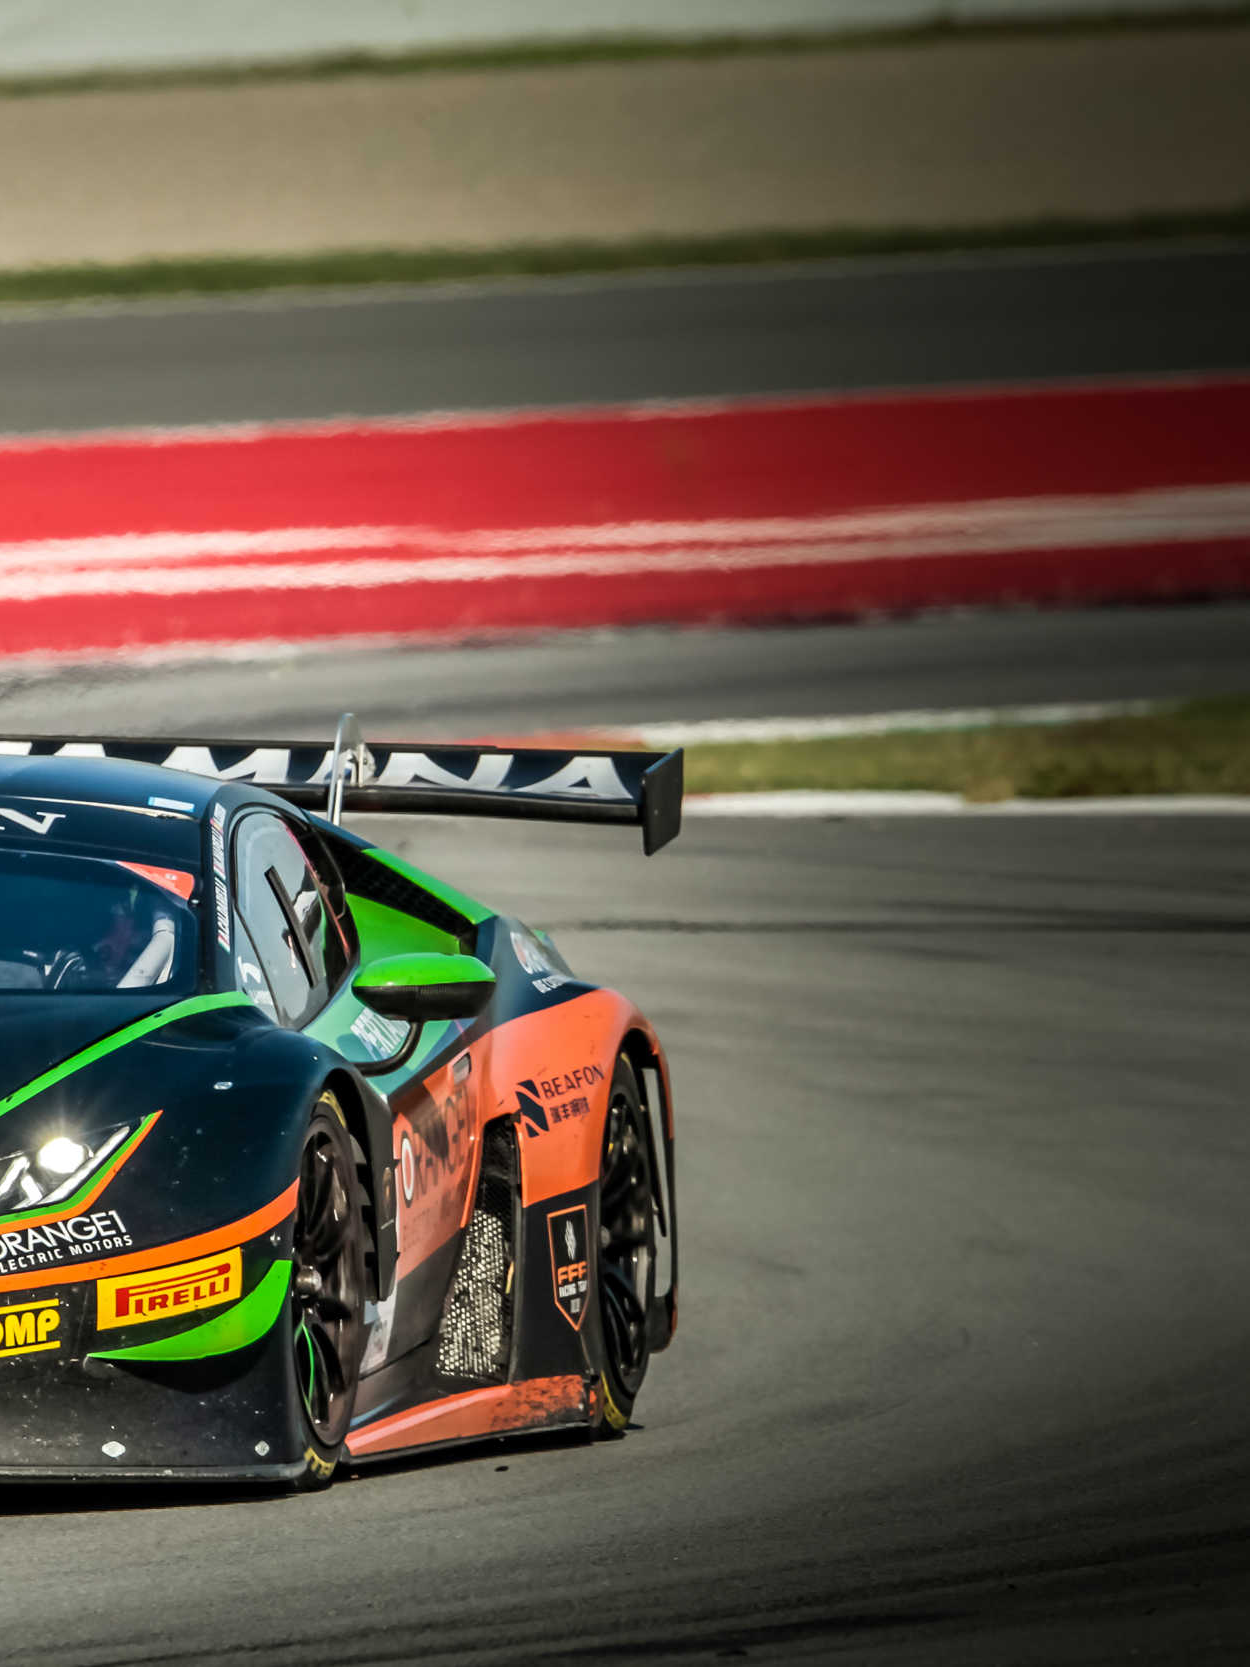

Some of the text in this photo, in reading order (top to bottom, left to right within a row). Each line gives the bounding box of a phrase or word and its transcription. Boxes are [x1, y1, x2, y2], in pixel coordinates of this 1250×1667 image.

[540, 1063, 605, 1099] BEAFON
[70, 1234, 133, 1256] MOTORS
[558, 1260, 588, 1286] FFF
[115, 1262, 231, 1318] PIRELLI
